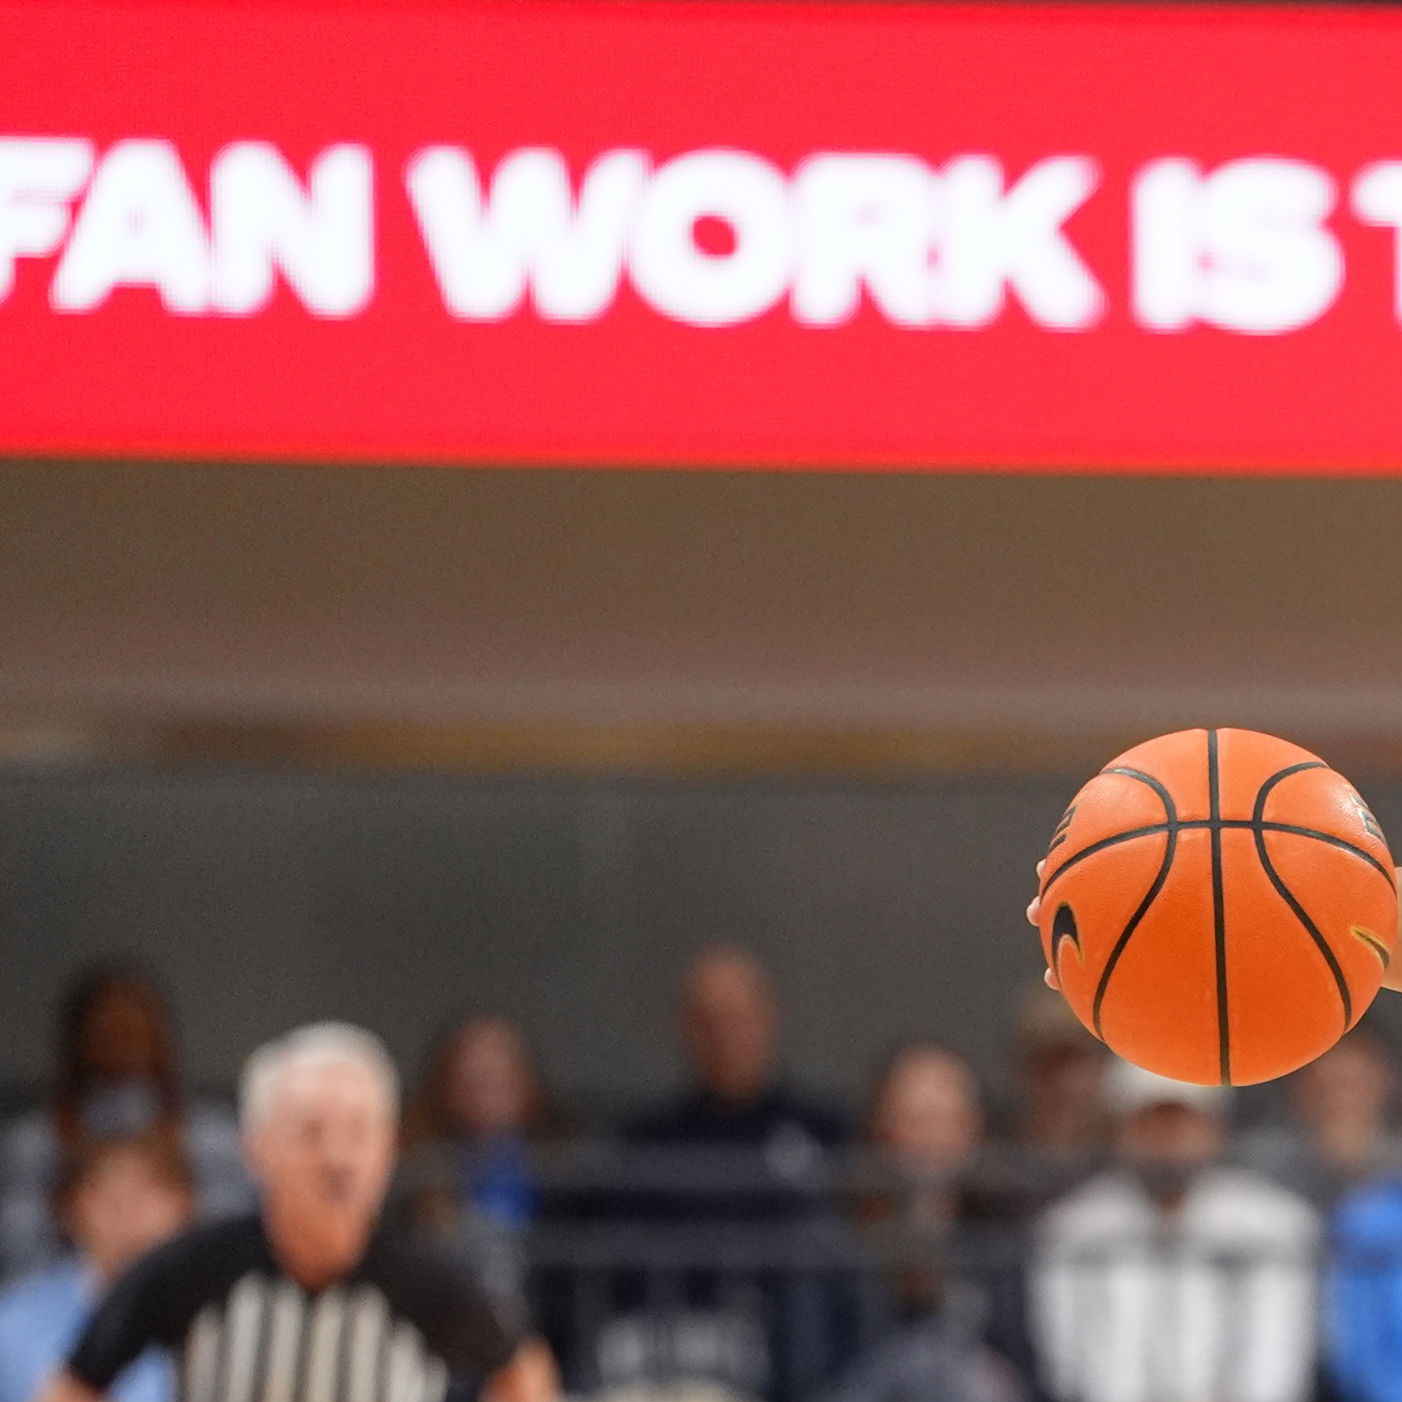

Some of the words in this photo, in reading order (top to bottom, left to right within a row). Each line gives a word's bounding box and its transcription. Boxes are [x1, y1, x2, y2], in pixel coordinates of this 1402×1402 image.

[0, 137, 374, 316] FAN
[406, 147, 1104, 327] WORK
[1131, 157, 1340, 335] IS
